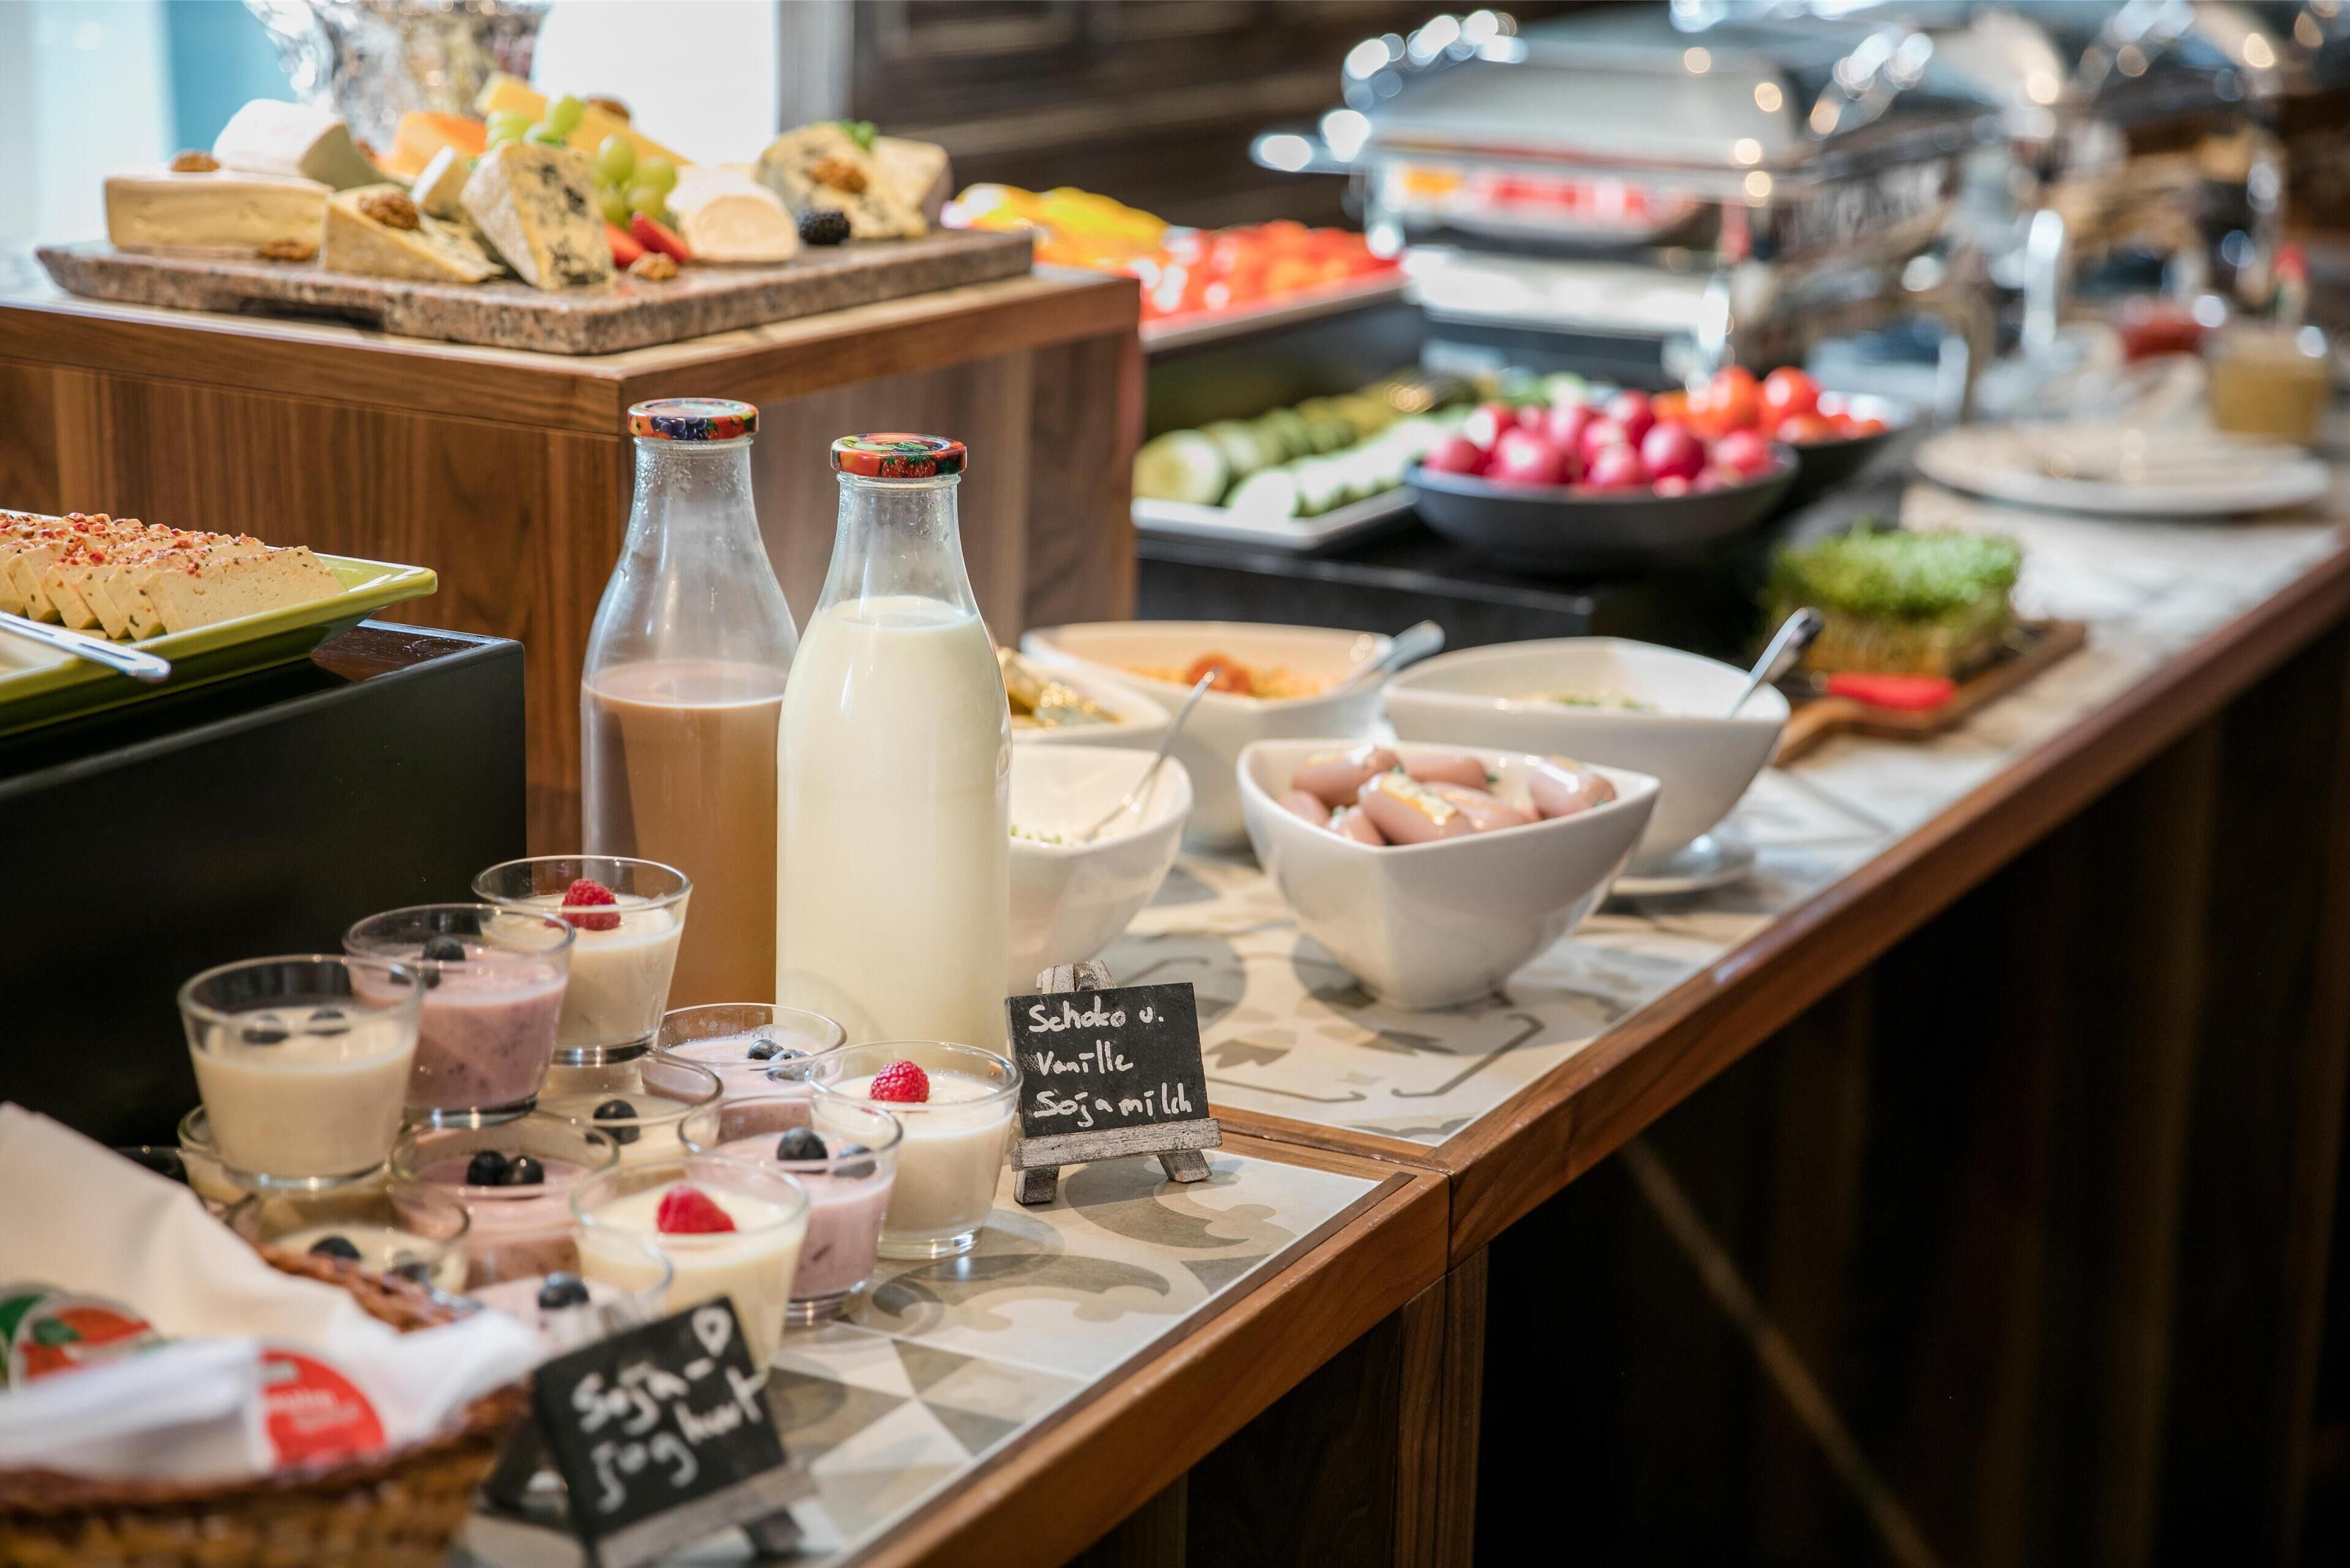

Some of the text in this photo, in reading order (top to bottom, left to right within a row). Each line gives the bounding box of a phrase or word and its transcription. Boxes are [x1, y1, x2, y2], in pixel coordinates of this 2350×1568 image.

[1028, 995, 1164, 1032] Schoko u.
[1036, 1039, 1134, 1076] Vanille
[1033, 1082, 1192, 1128] Sojamilch
